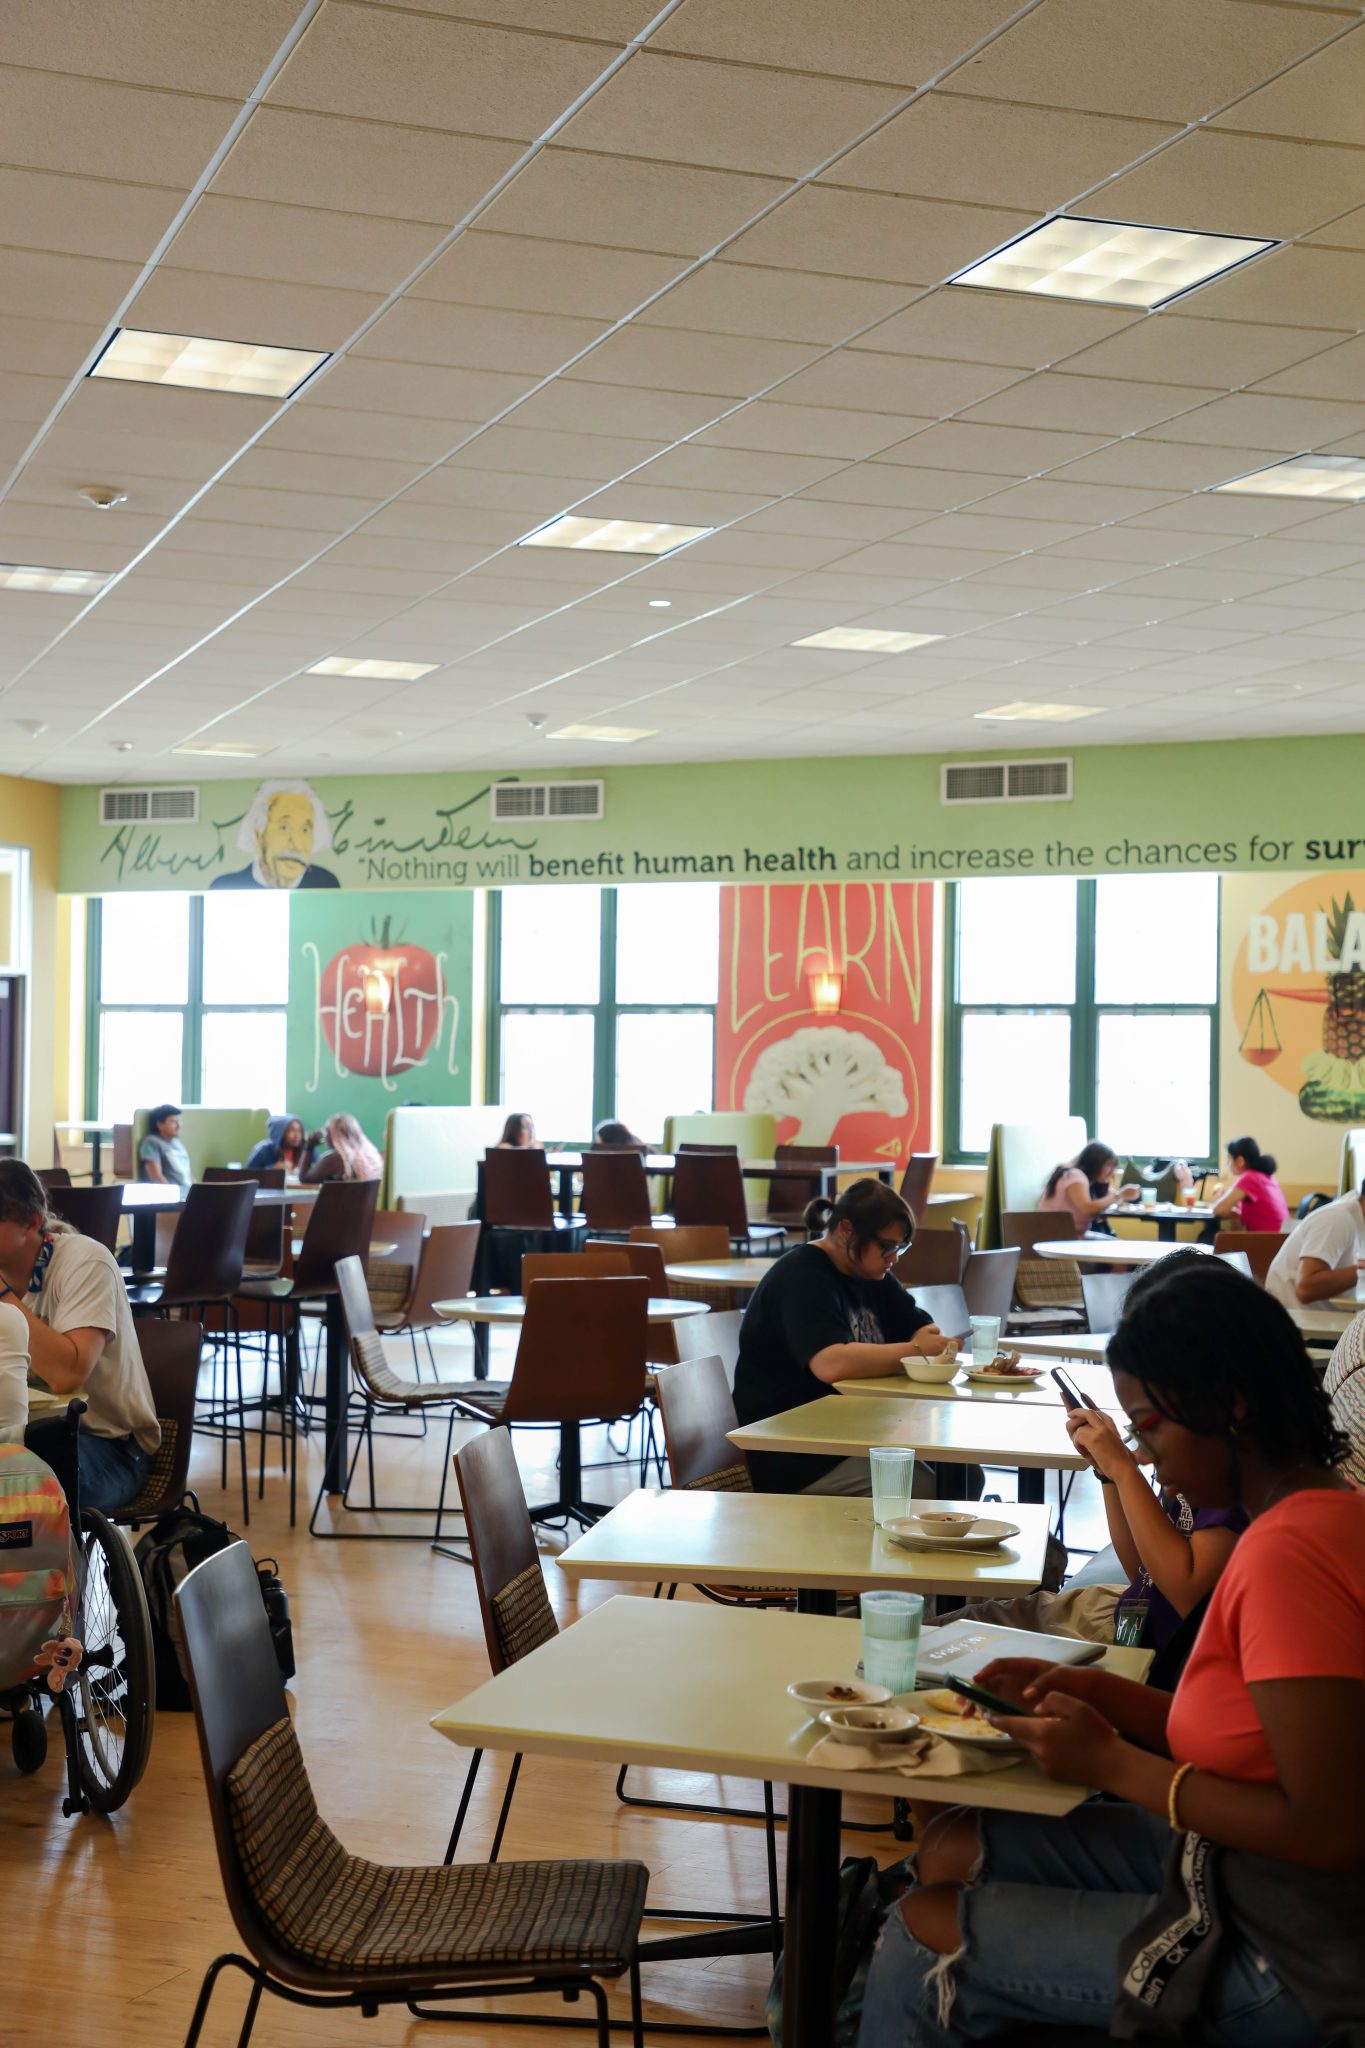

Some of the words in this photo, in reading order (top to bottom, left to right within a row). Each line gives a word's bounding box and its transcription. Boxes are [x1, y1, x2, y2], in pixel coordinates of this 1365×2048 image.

[476, 854, 520, 878] will
[529, 852, 624, 877] benefit
[634, 851, 734, 874] human
[744, 847, 836, 872] health
[847, 845, 900, 870] and
[911, 844, 1034, 869] increase
[1046, 841, 1094, 867] the
[1105, 839, 1237, 865] chances
[1250, 834, 1294, 862] for
[1305, 838, 1365, 860] sur
[1131, 1938, 1169, 1983] Calvin
